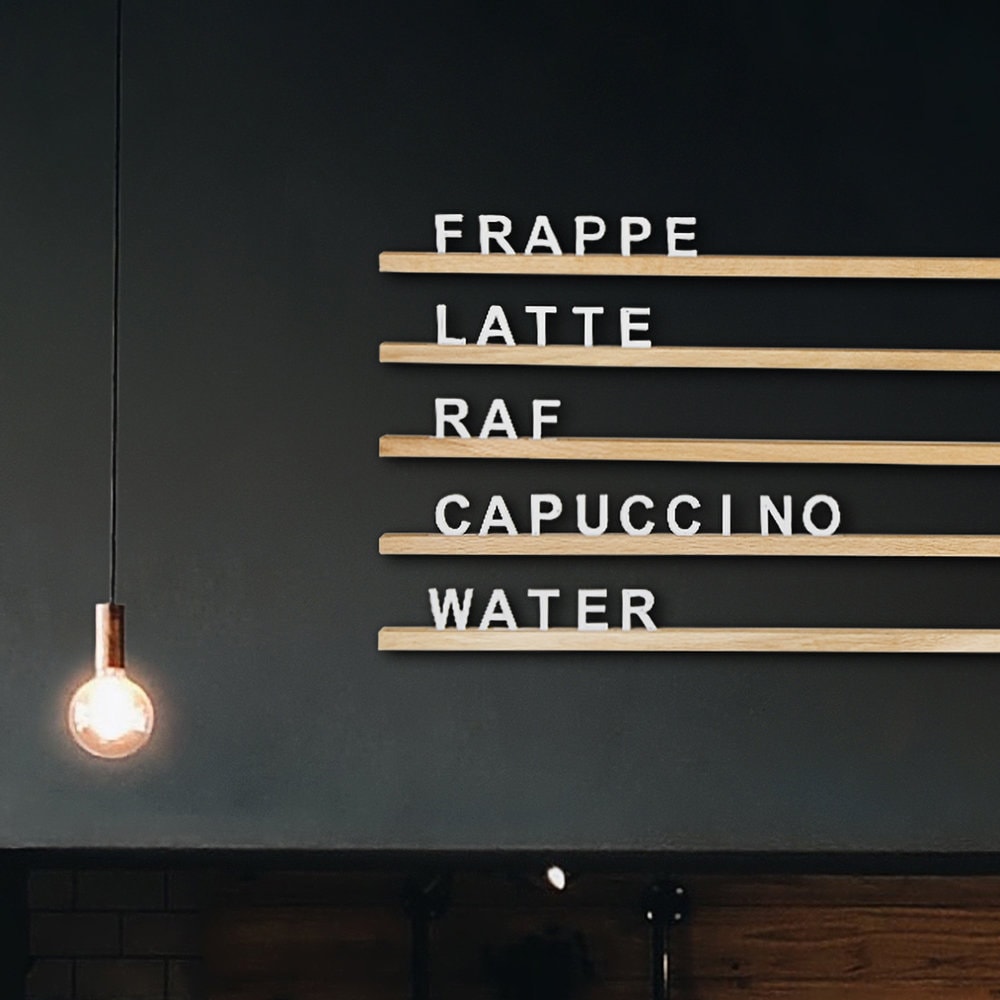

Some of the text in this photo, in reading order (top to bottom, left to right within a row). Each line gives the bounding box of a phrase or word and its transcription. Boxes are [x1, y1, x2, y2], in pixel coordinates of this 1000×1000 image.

[434, 213, 698, 257] FRAPPE
[436, 304, 652, 348] LATTE
[434, 397, 562, 440] RAF
[434, 493, 842, 537] CAPUCCINO
[427, 587, 658, 631] WATER
